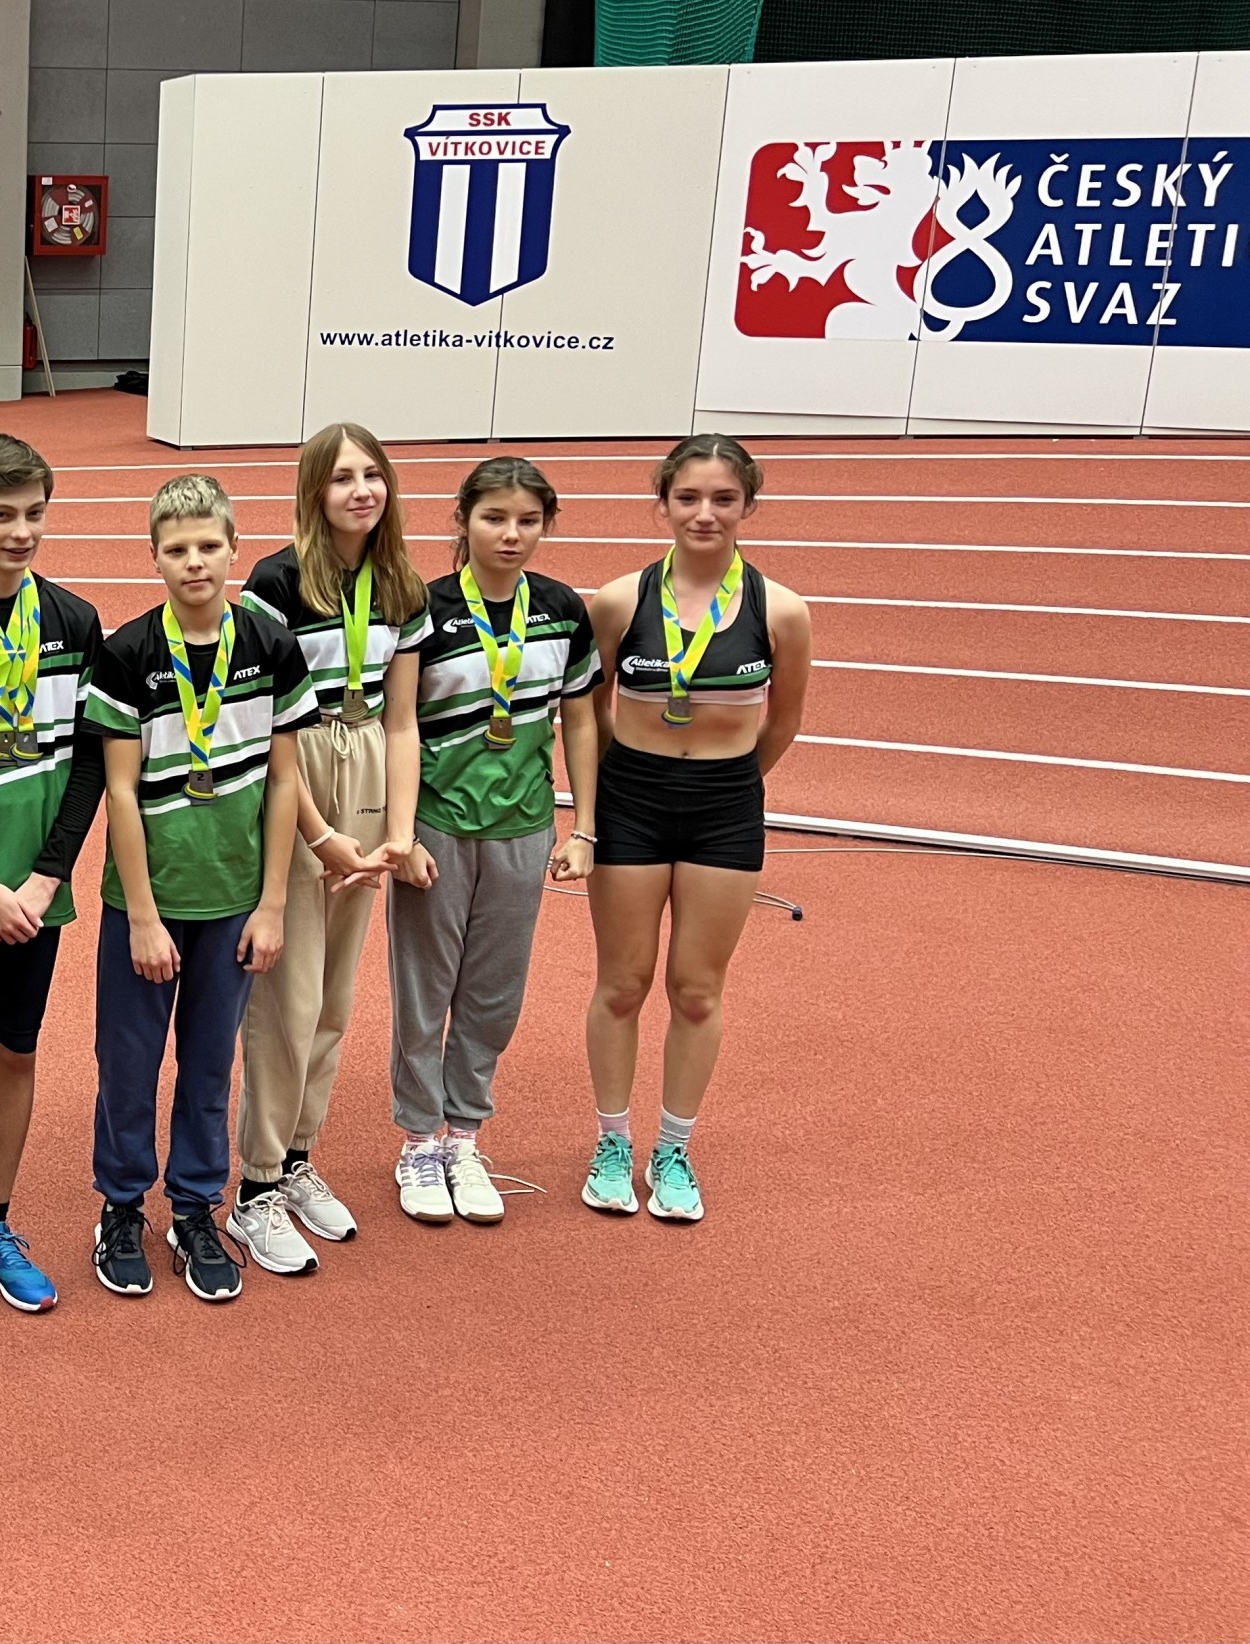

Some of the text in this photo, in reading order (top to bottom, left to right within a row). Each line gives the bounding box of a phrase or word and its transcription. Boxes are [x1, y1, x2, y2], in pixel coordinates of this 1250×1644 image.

[468, 112, 512, 127] SSK
[428, 136, 546, 156] VÍTKOVICE
[1037, 150, 1234, 207] ČESKÝ
[1022, 281, 1182, 325] SVAZ
[320, 329, 615, 350] www.atletika-vitkovice.cz
[39, 640, 65, 653] ATEX
[233, 664, 261, 680] ATEX
